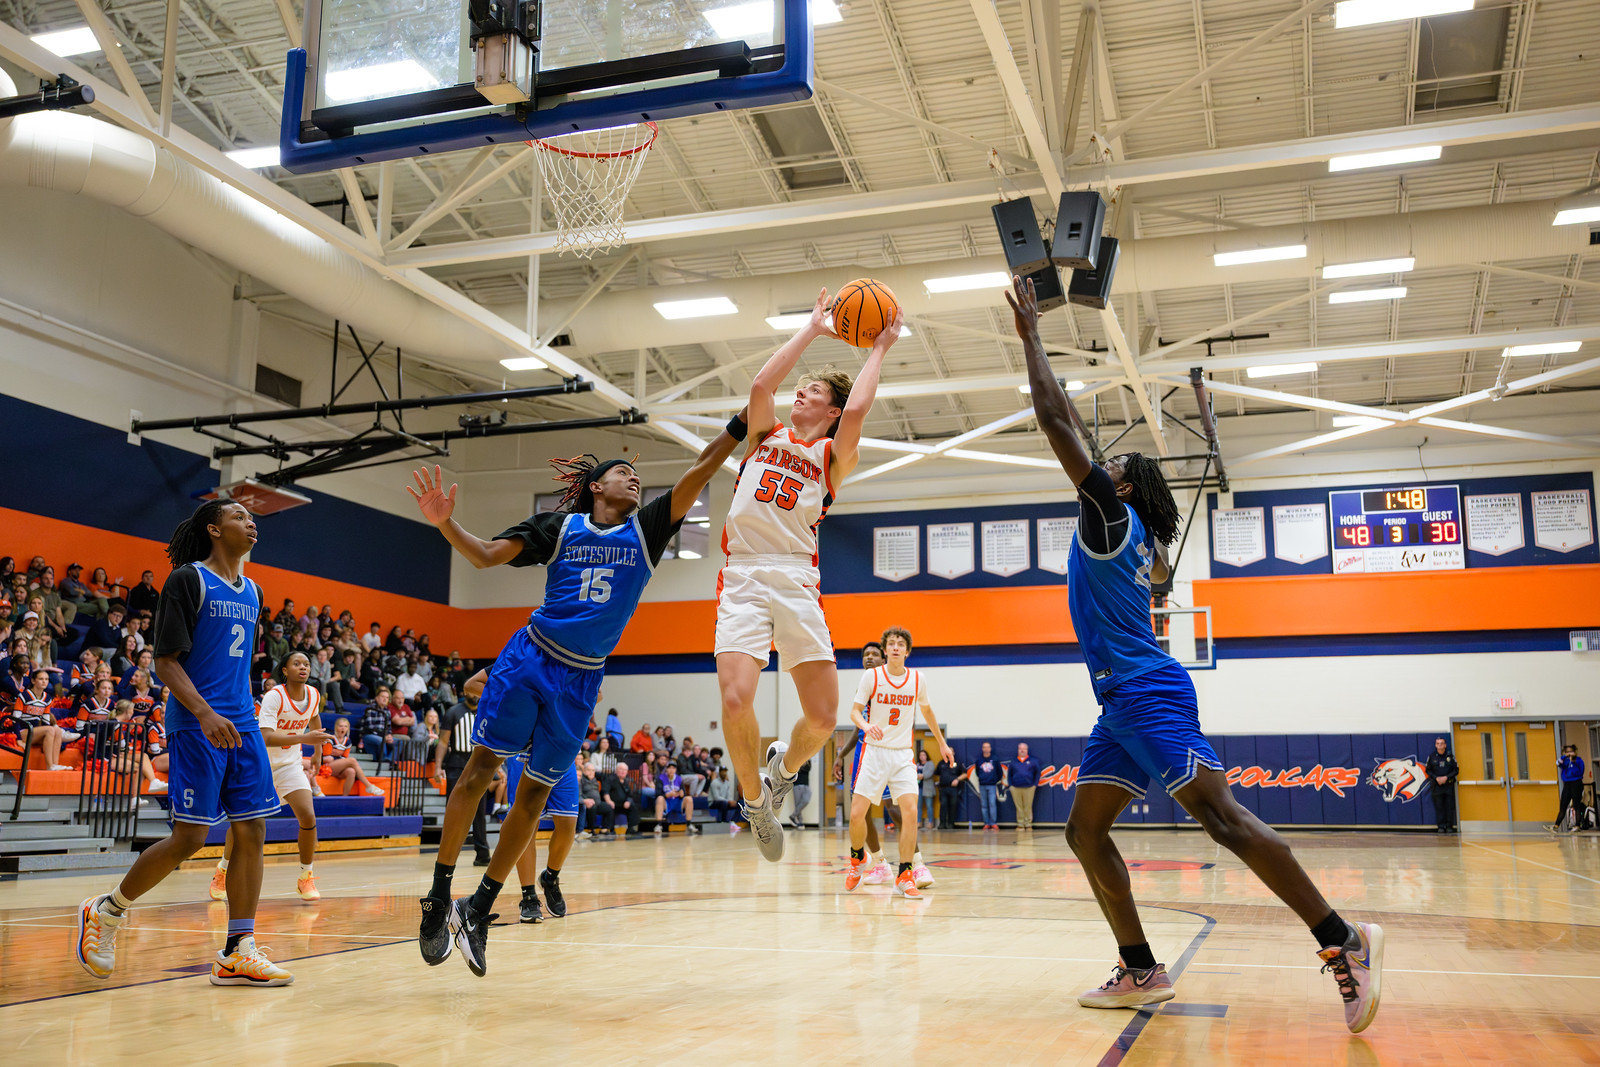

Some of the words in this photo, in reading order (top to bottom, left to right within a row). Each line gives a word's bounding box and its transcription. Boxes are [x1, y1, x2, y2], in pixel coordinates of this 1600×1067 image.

[755, 444, 822, 485] CARSON
[754, 468, 805, 511] 55
[1385, 489, 1425, 510] 1:48
[1340, 515, 1367, 525] HOME
[1383, 517, 1407, 526] PERIOD
[1422, 511, 1453, 521] GUEST
[1343, 526, 1371, 546] 48
[1391, 525, 1402, 543] 3
[1431, 521, 1457, 543] 30
[564, 545, 638, 567] STATESVILLE
[578, 567, 615, 604] 15
[229, 624, 245, 657] 2
[877, 693, 914, 706] CARSON
[1500, 697, 1514, 708] EXIT
[888, 707, 901, 726] 2
[477, 718, 488, 738] S
[1225, 764, 1361, 798] COUGARS
[183, 788, 194, 809] S
